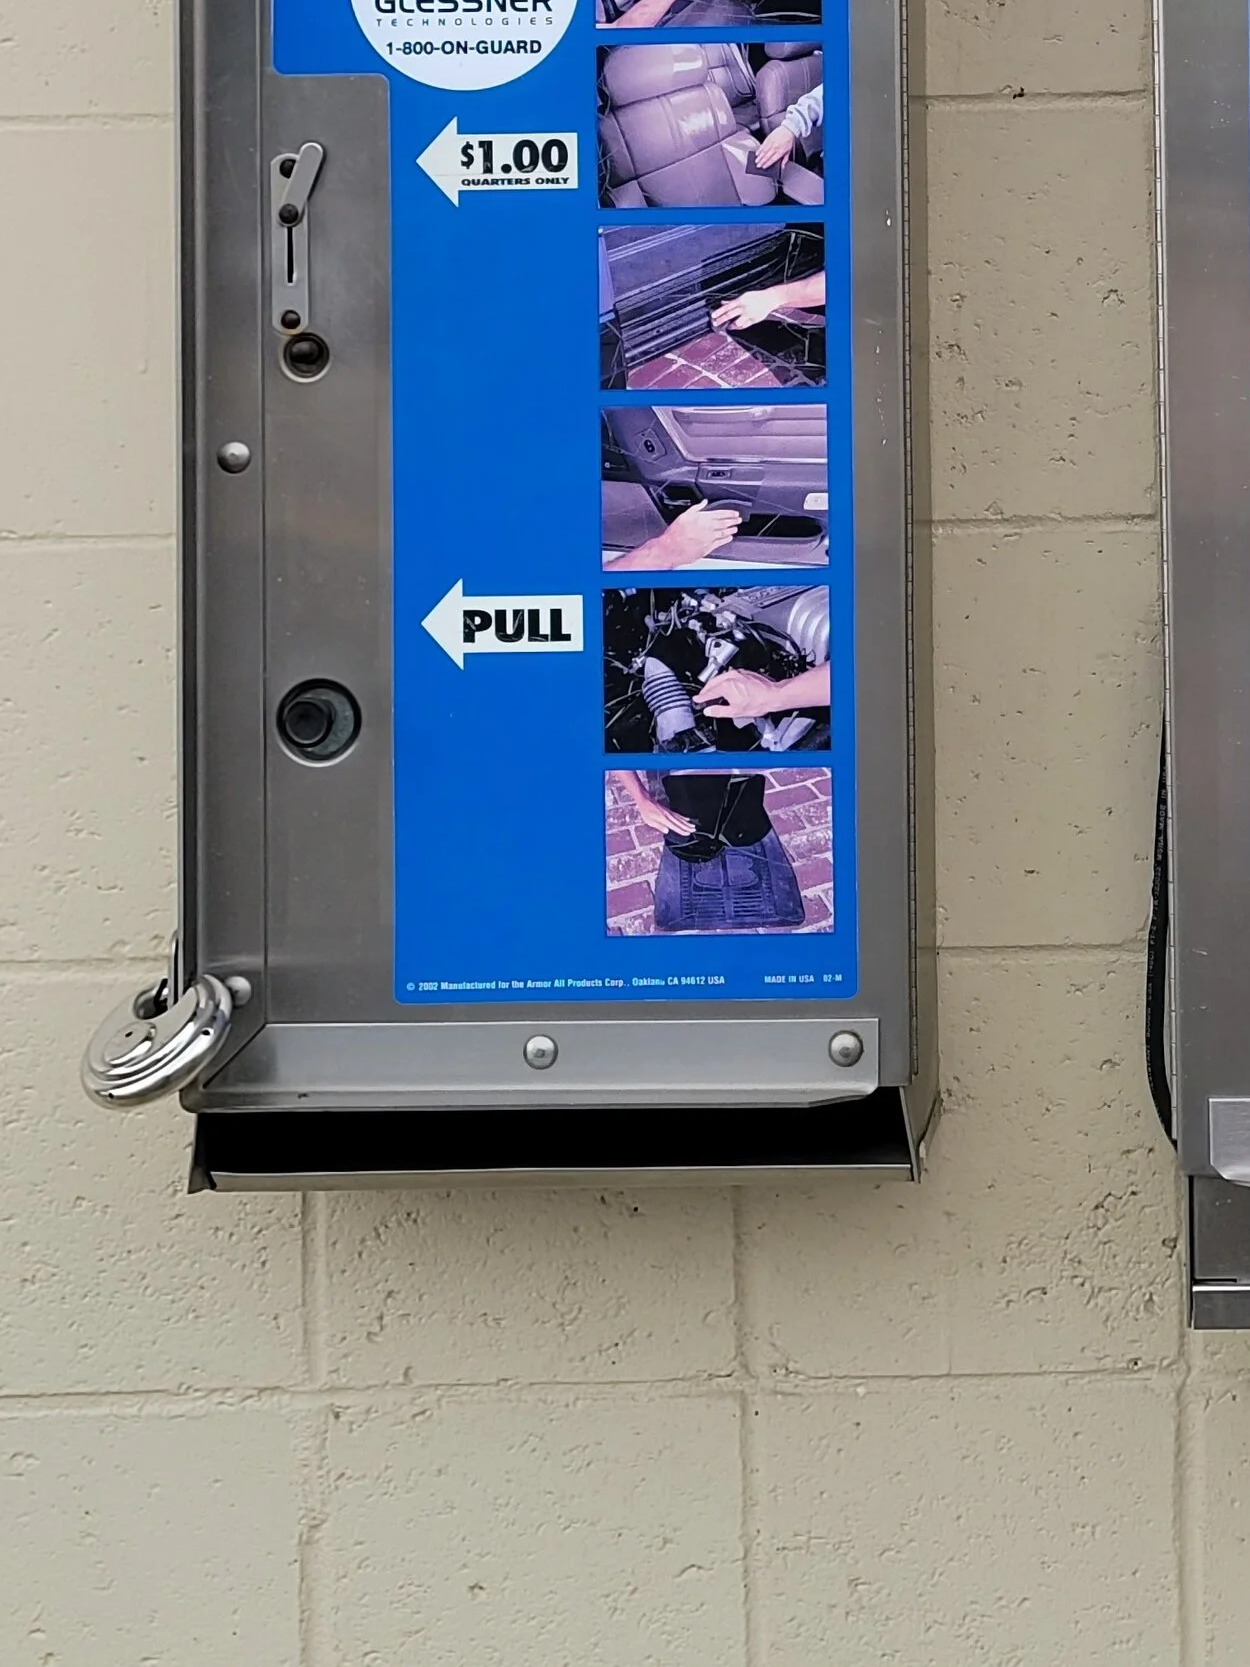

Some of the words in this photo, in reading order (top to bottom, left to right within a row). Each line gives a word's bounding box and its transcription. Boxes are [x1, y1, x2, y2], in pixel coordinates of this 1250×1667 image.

[376, 17, 554, 27] TECHNOLOGIES
[385, 39, 543, 56] 1-800-ON-GUARD
[461, 138, 569, 175] $1.00
[461, 177, 531, 186] QUARTERS
[535, 176, 570, 185] ONLY
[462, 608, 572, 643] PULL
[764, 975, 786, 984] MADE
[798, 974, 815, 983] USA
